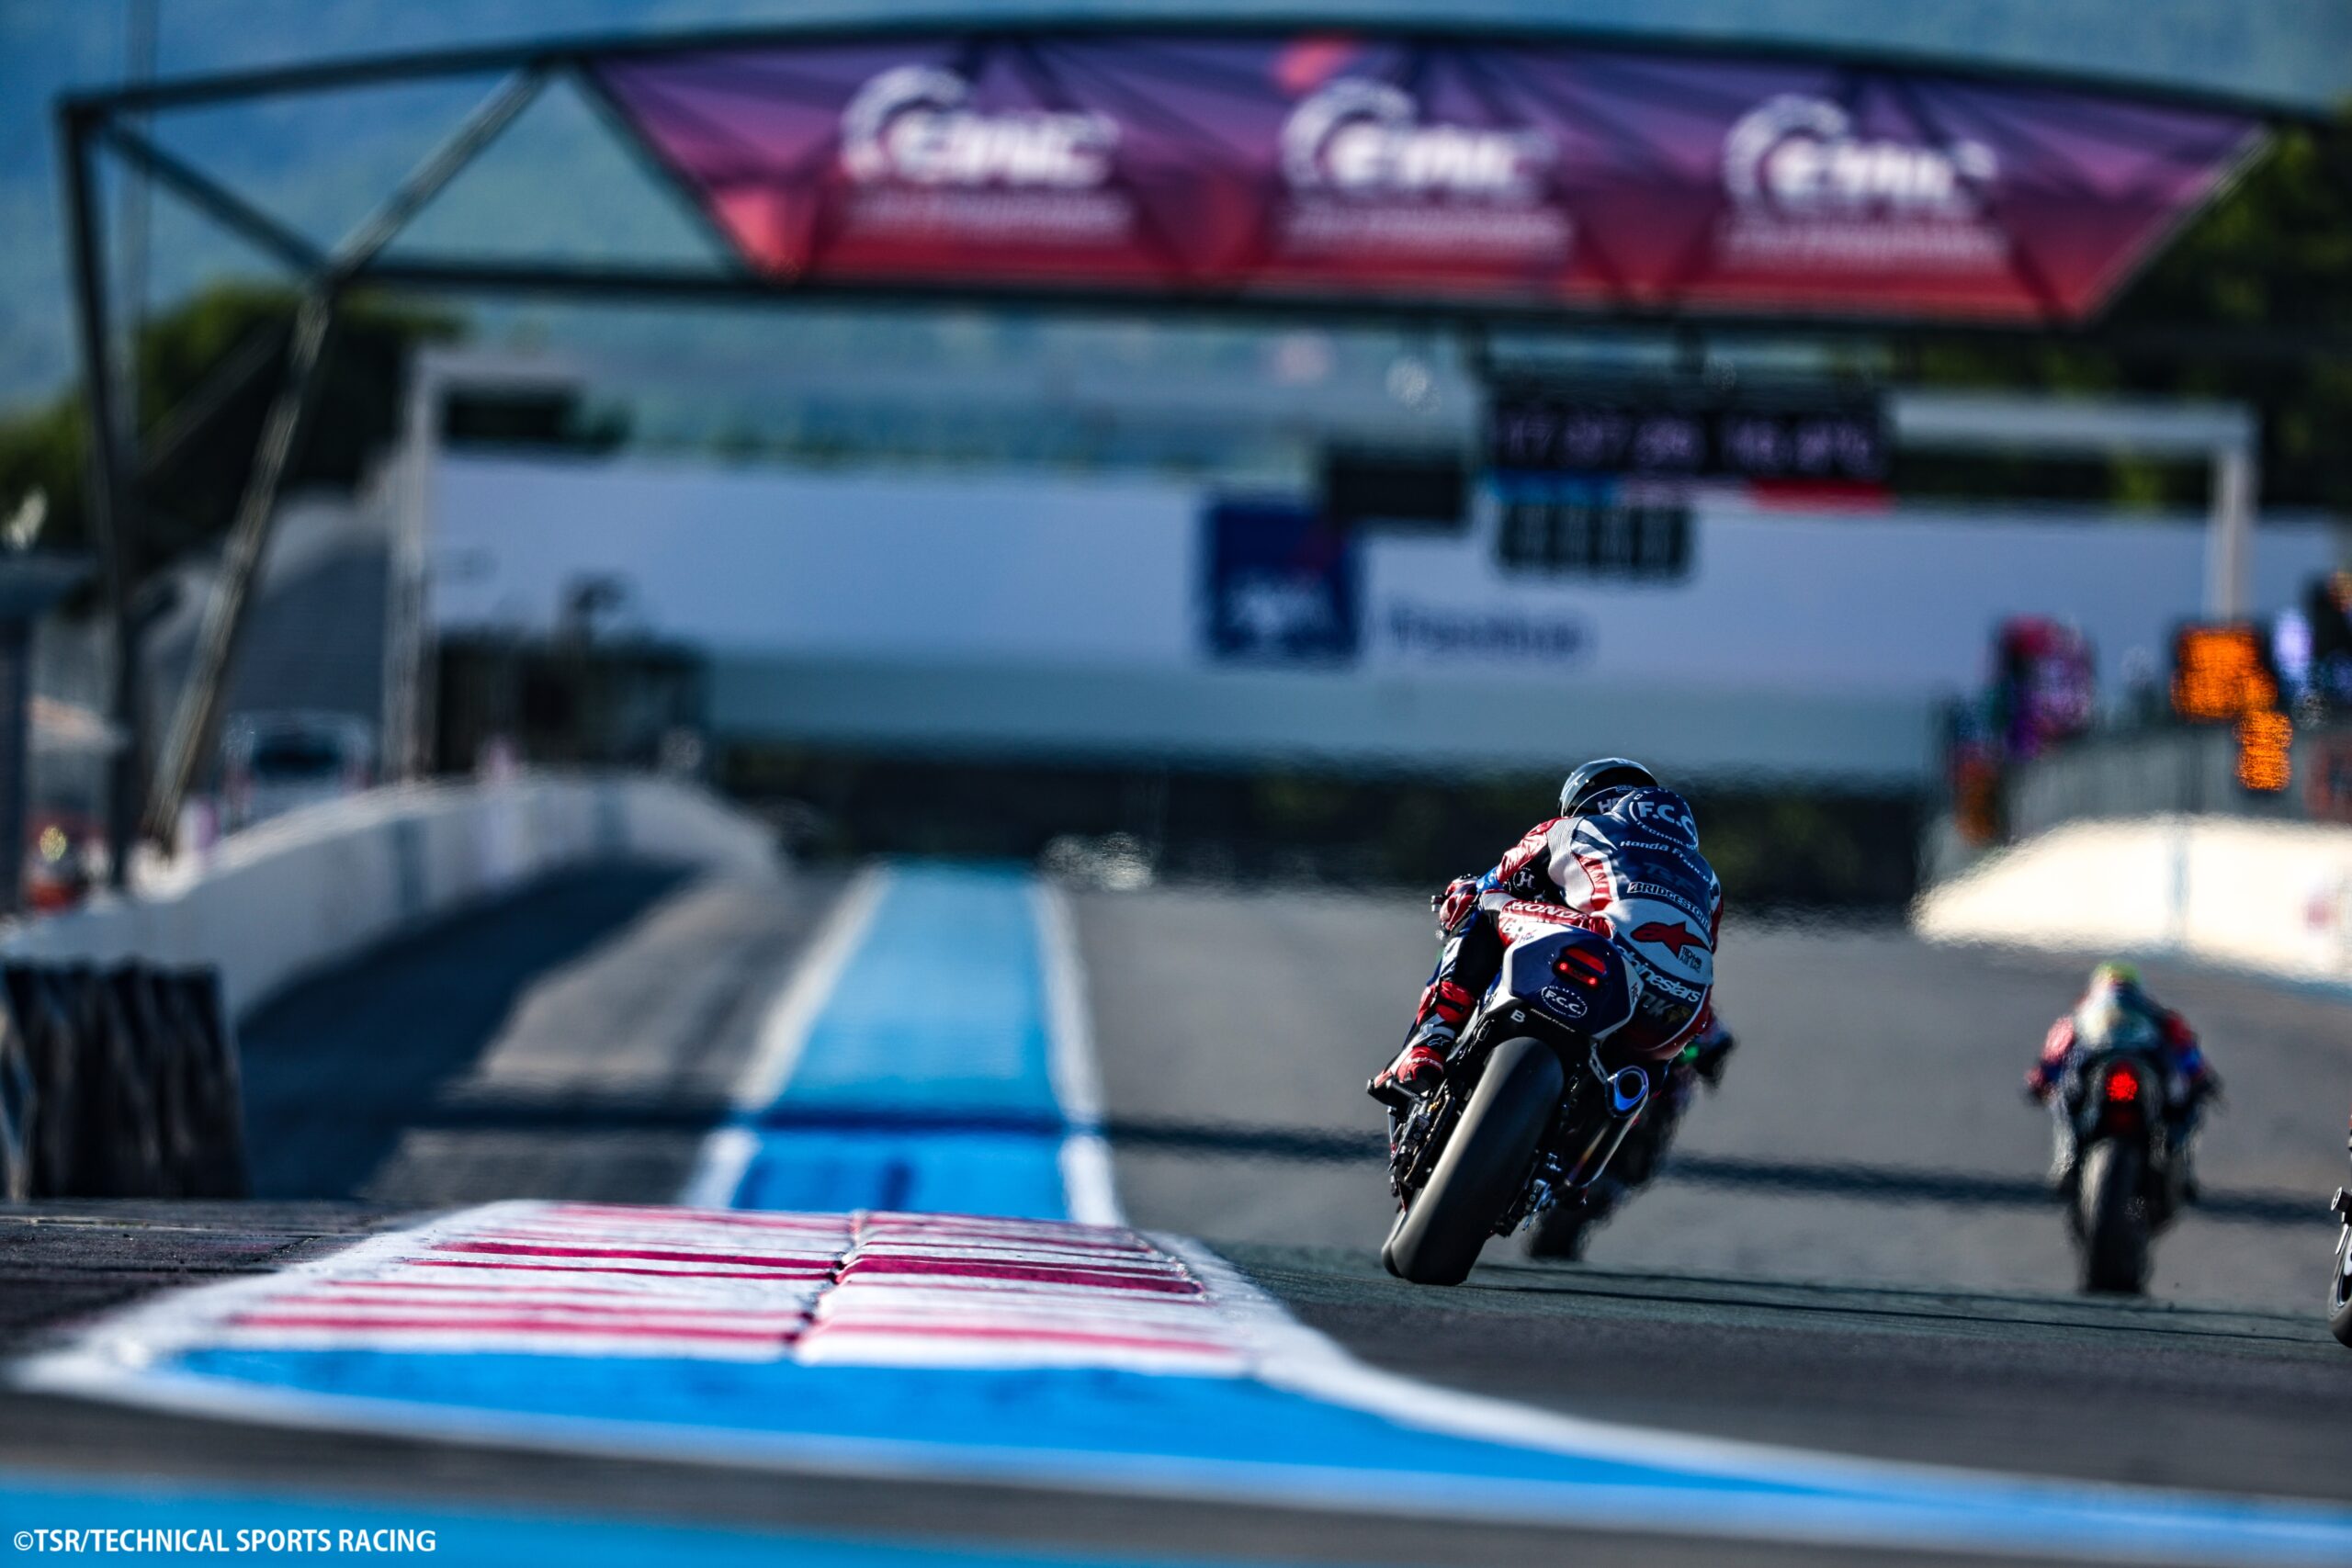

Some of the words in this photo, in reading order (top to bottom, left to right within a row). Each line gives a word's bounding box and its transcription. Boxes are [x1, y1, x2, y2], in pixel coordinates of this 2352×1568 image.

[1620, 840, 1669, 852] Honda
[1544, 989, 1582, 1015] F.C.C.
[1510, 1009, 1527, 1023] B
